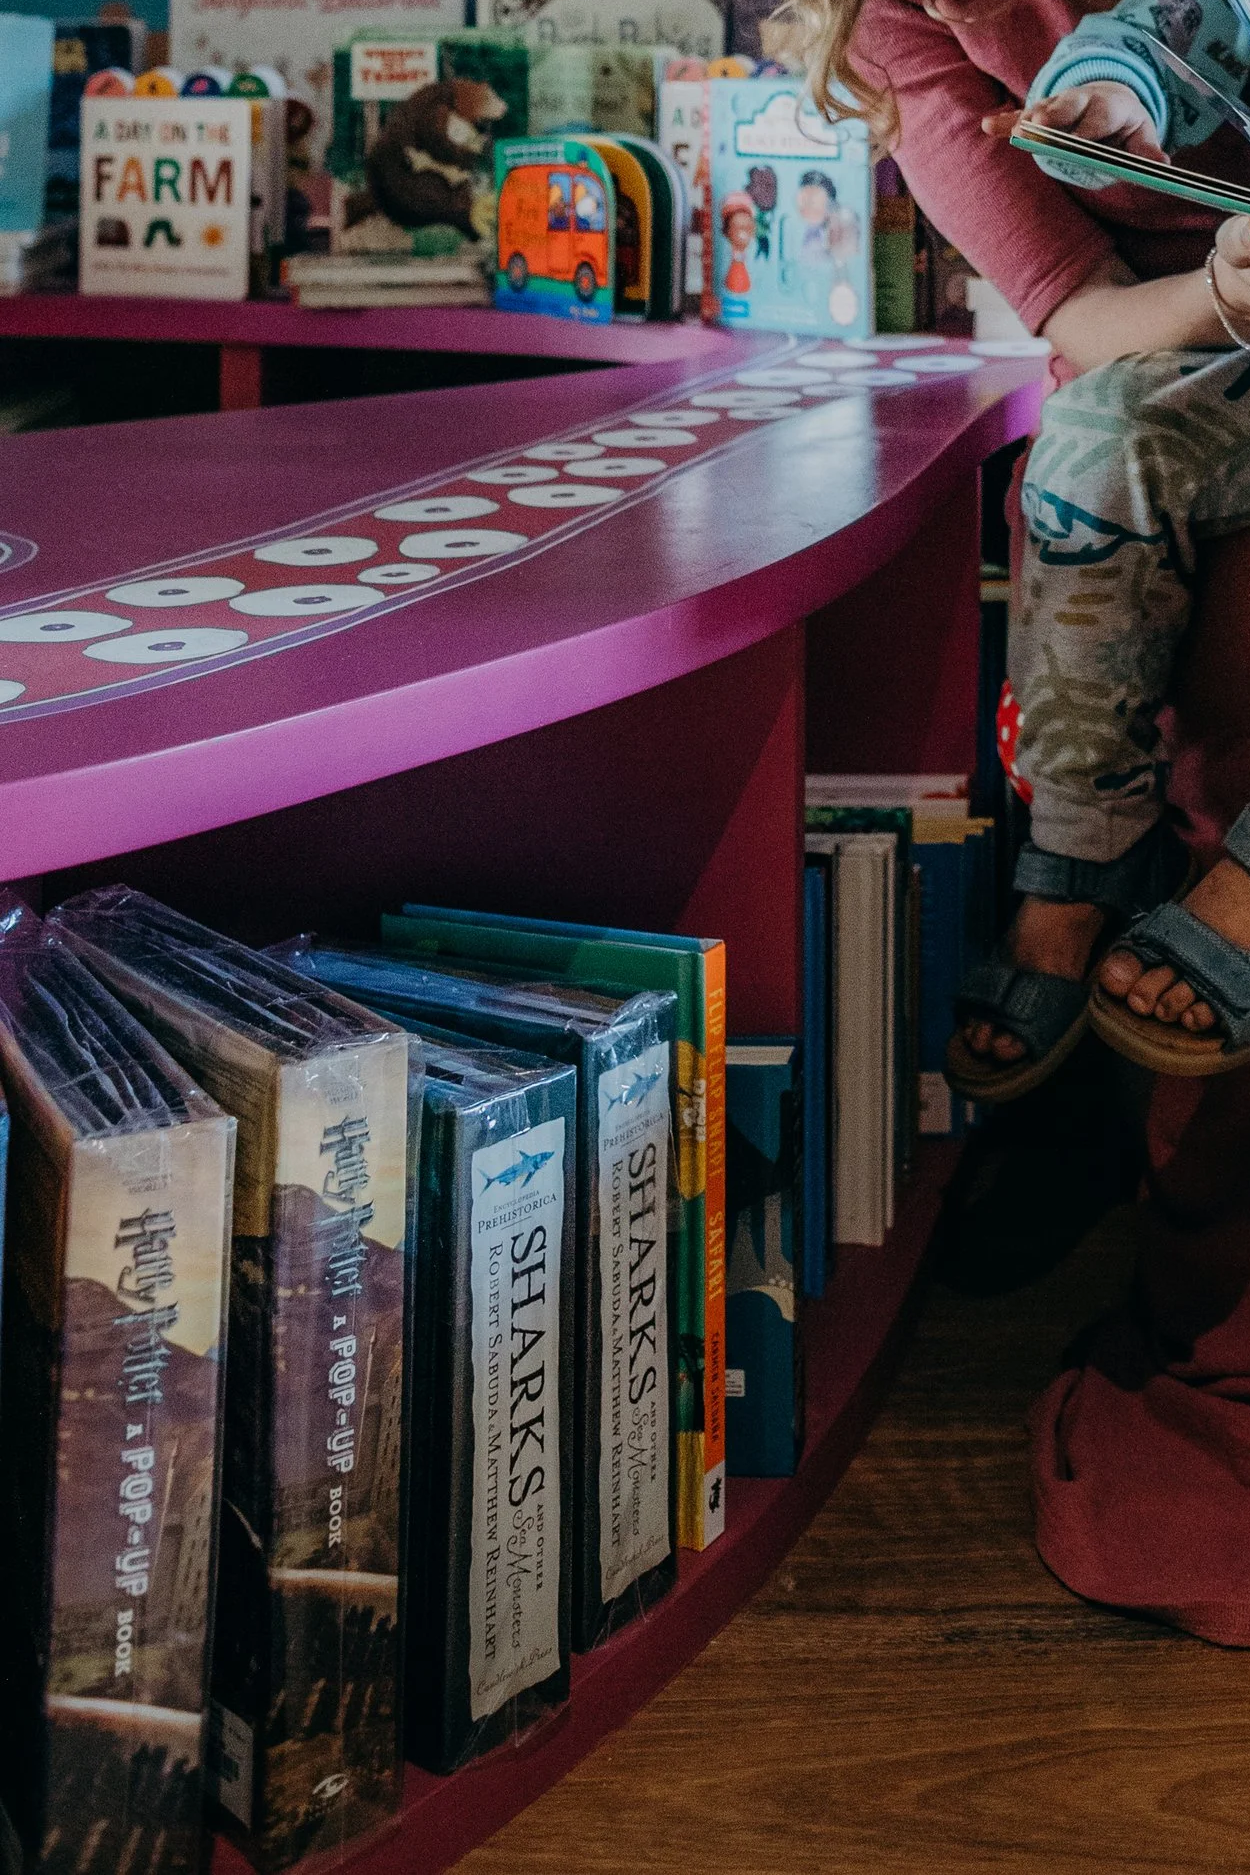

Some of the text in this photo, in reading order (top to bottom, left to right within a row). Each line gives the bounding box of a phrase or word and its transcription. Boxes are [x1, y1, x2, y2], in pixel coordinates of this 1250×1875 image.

[95, 120, 231, 143] A DAY ON THE
[95, 156, 234, 205] FARM
[707, 987, 724, 1035] FLIP
[477, 1192, 558, 1234] PREHISTORICA
[611, 1159, 624, 1237] ROBERT
[488, 1240, 504, 1322] ROBERT
[611, 1243, 624, 1326] SABUDA
[628, 1142, 658, 1405] SHARKS
[707, 1210, 724, 1302] SAFARI
[488, 1332, 503, 1422] SABUDA
[508, 1225, 547, 1507] SHARKS
[611, 1334, 623, 1437] MATTHEW
[326, 1314, 358, 1549] A POP-UP BOOK
[486, 1431, 502, 1542] MATTHEW
[610, 1442, 623, 1546] REINHART
[114, 1424, 156, 1677] A POP-UP BOOK
[506, 1508, 534, 1649] Sea Monsters
[535, 1503, 545, 1592] AND OTHER
[485, 1546, 501, 1661] REINHART
